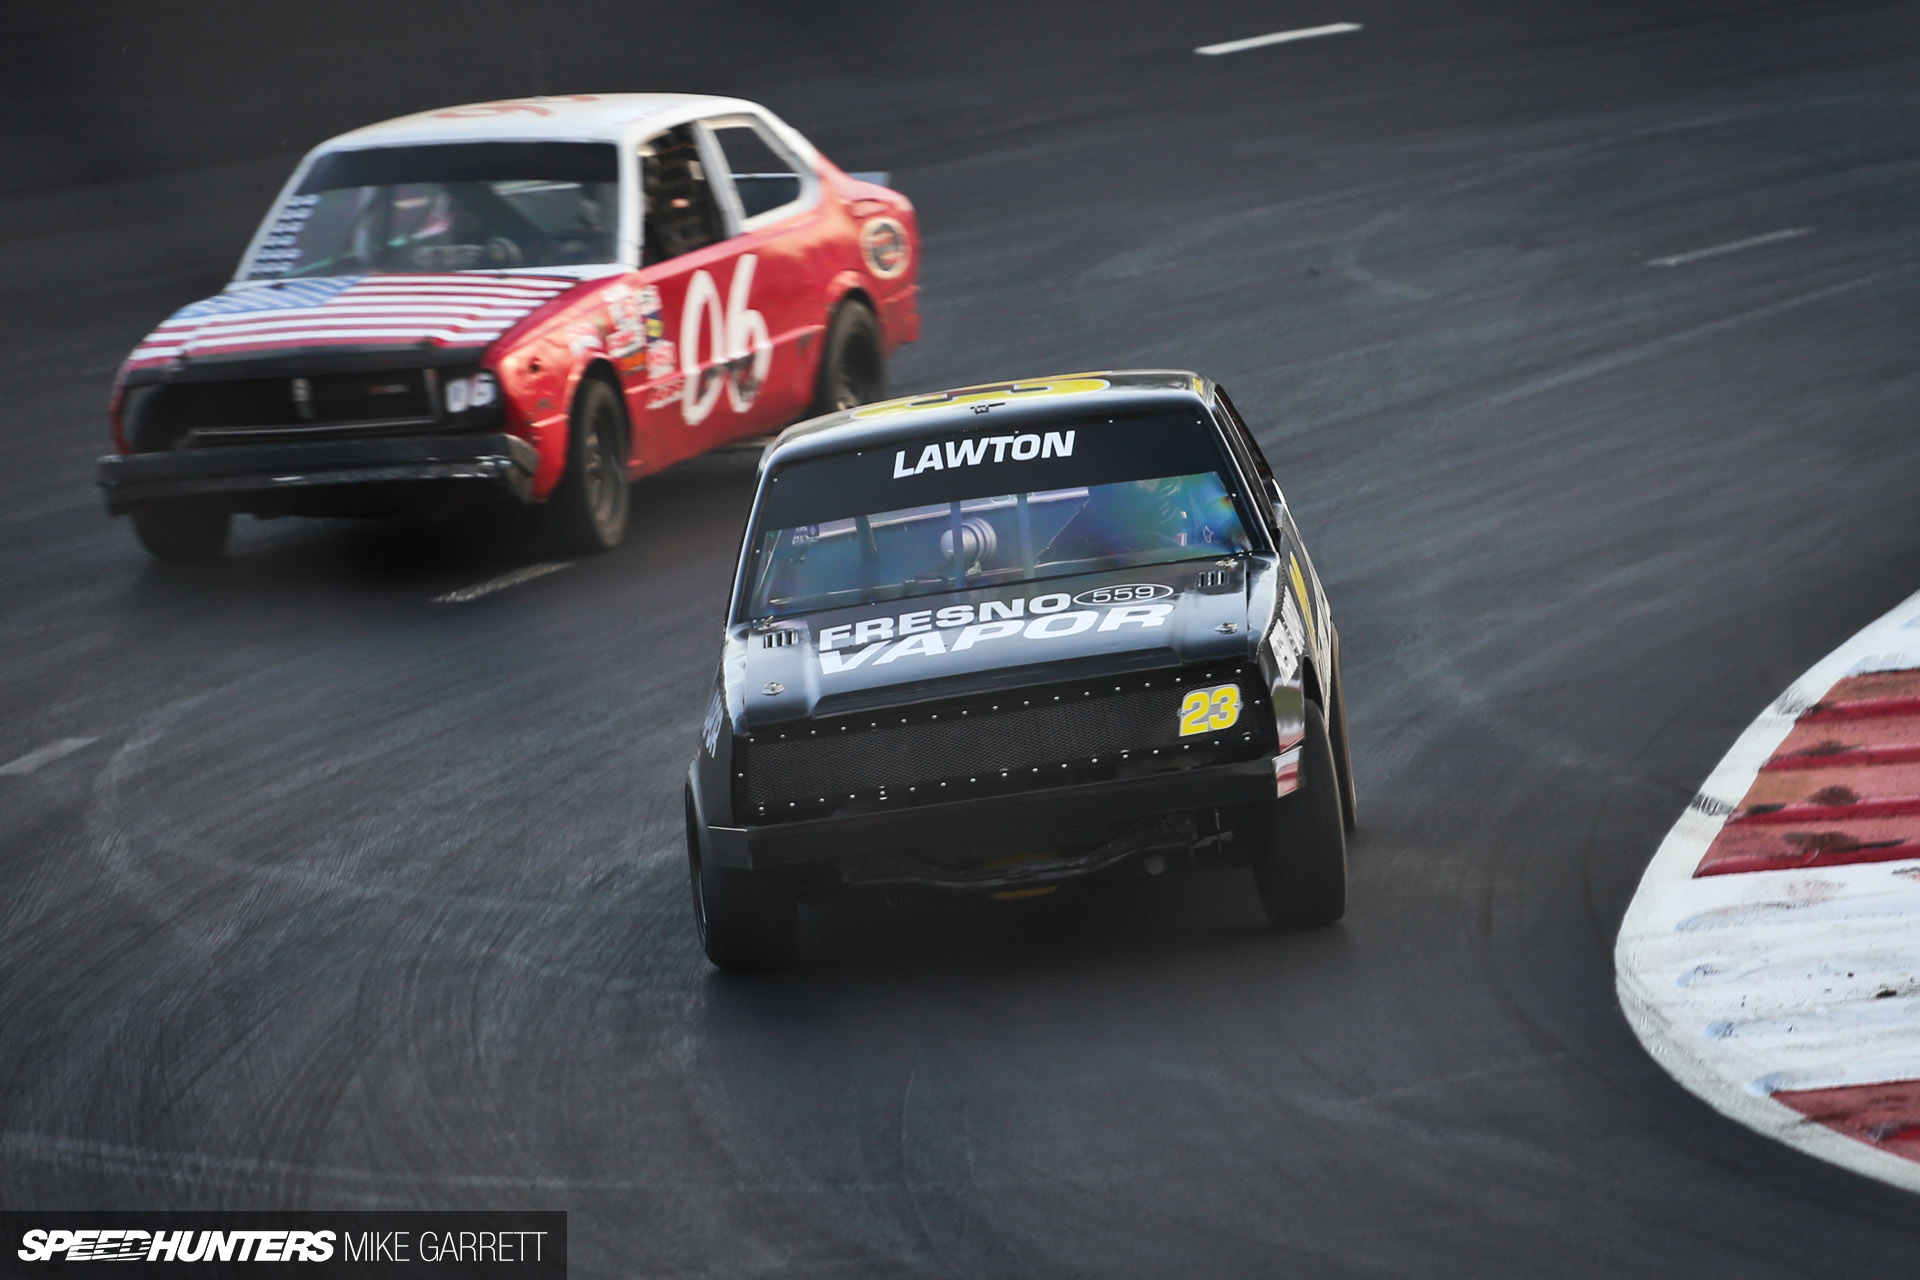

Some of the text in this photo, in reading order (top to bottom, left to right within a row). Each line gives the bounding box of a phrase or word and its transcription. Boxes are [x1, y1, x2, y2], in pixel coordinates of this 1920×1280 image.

[679, 253, 773, 426] 06
[445, 372, 496, 413] 06
[892, 430, 1076, 480] LAWTON
[1092, 586, 1155, 603] 559
[818, 592, 1072, 651] FRESNO
[818, 603, 1175, 675] VAPOR
[1179, 684, 1240, 736] 23
